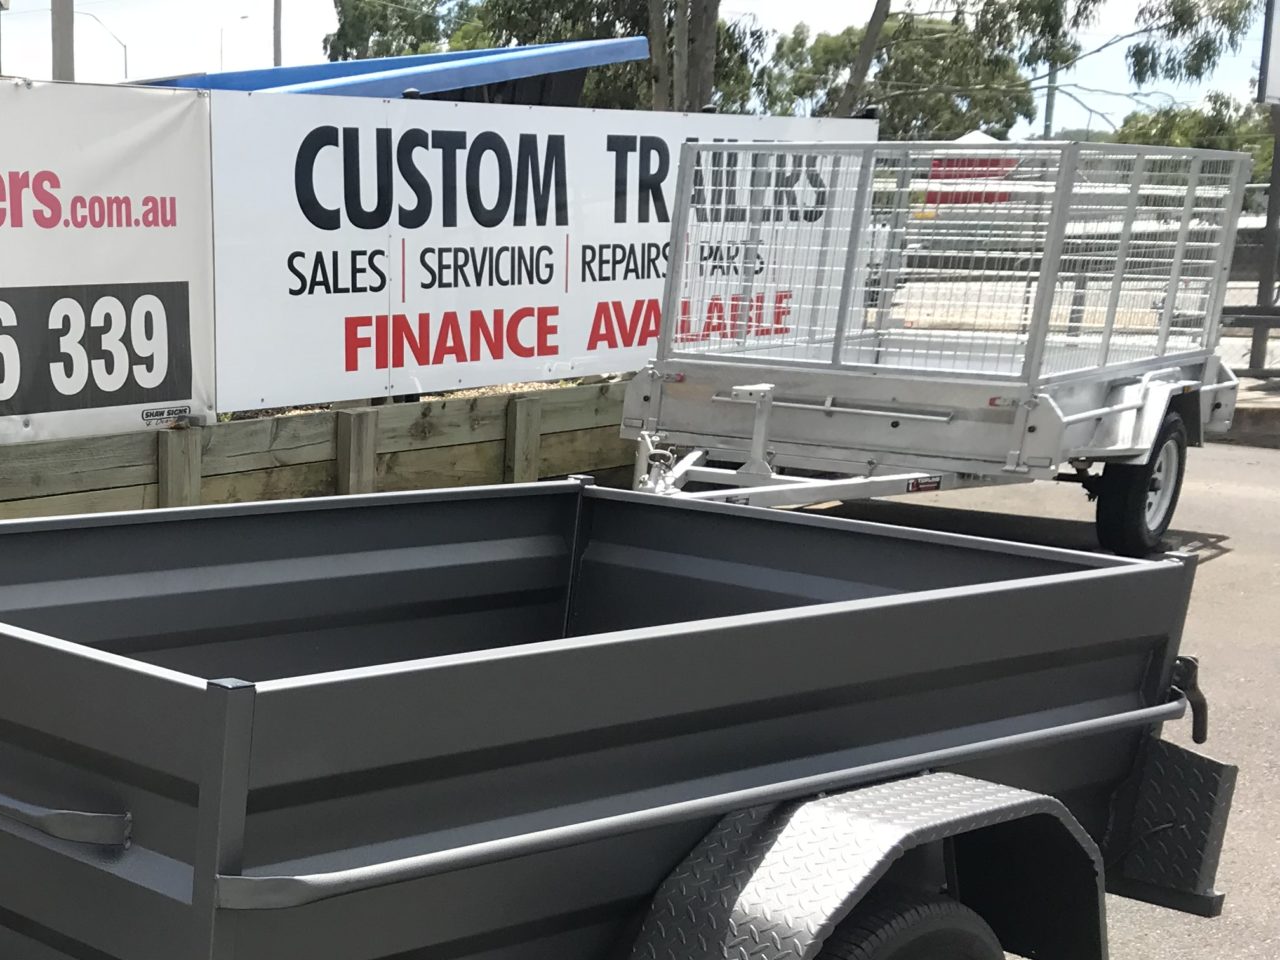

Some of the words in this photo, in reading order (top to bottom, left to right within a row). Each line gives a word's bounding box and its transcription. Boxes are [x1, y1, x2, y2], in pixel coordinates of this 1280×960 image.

[294, 125, 569, 231] CUSTOM
[286, 248, 387, 296] SALES
[419, 244, 554, 290] SERVICING
[580, 242, 671, 282] REPAIRS
[47, 294, 169, 396] 339
[344, 305, 559, 373] FINANCE
[586, 291, 793, 351] AVALABLE
[144, 409, 165, 419] SHAW
